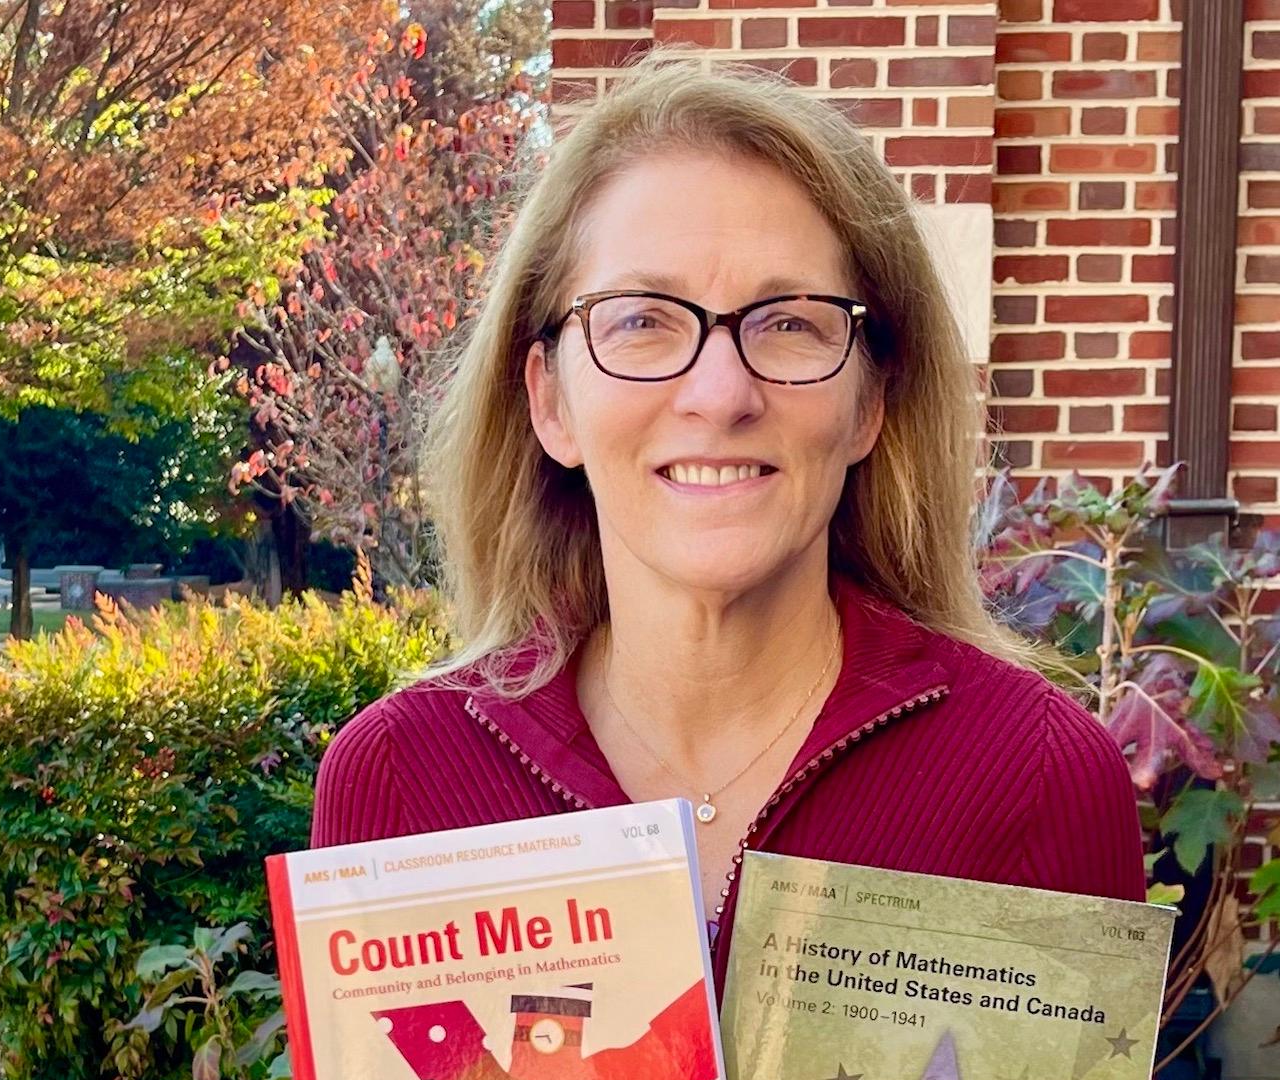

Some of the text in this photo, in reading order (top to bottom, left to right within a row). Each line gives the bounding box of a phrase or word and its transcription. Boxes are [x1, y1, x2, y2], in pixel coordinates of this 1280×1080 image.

[622, 824, 660, 839] VOL 68
[304, 870, 330, 884] AMS
[339, 866, 367, 879] MAA
[384, 854, 454, 873] CLASSROOM
[456, 843, 515, 863] RESOURCE
[518, 834, 582, 854] MATERIALS
[771, 880, 798, 894] AMS
[808, 885, 836, 899] MAA
[856, 891, 920, 911] SPECTRUM
[328, 898, 613, 976] Count Me In
[1102, 925, 1122, 939] VOL
[332, 951, 621, 1000] Community and Belonging in Mathematics
[763, 932, 1036, 987] A History of Mathematics
[757, 990, 817, 1013] Volume
[822, 1000, 836, 1016] 2:
[759, 959, 1105, 1024] in the United States and Canada
